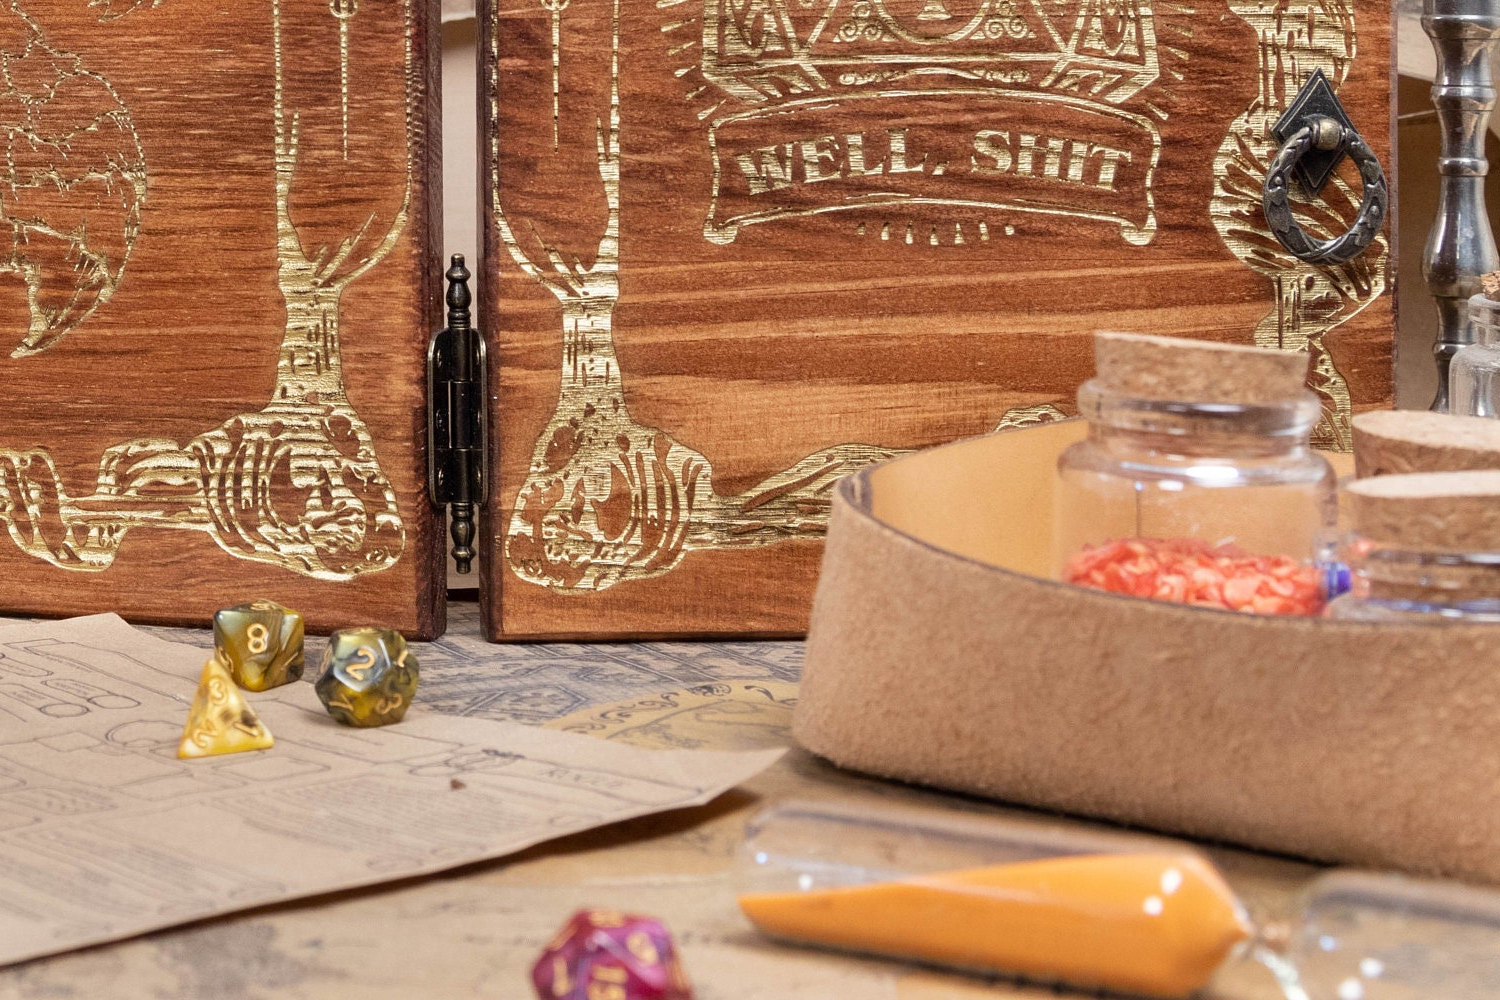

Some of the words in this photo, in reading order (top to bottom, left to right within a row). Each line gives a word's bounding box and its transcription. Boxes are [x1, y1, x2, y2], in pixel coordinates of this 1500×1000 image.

[736, 127, 949, 196] WELL,
[971, 130, 1132, 192] SHIT
[247, 623, 268, 654] 8
[345, 648, 376, 681] 2
